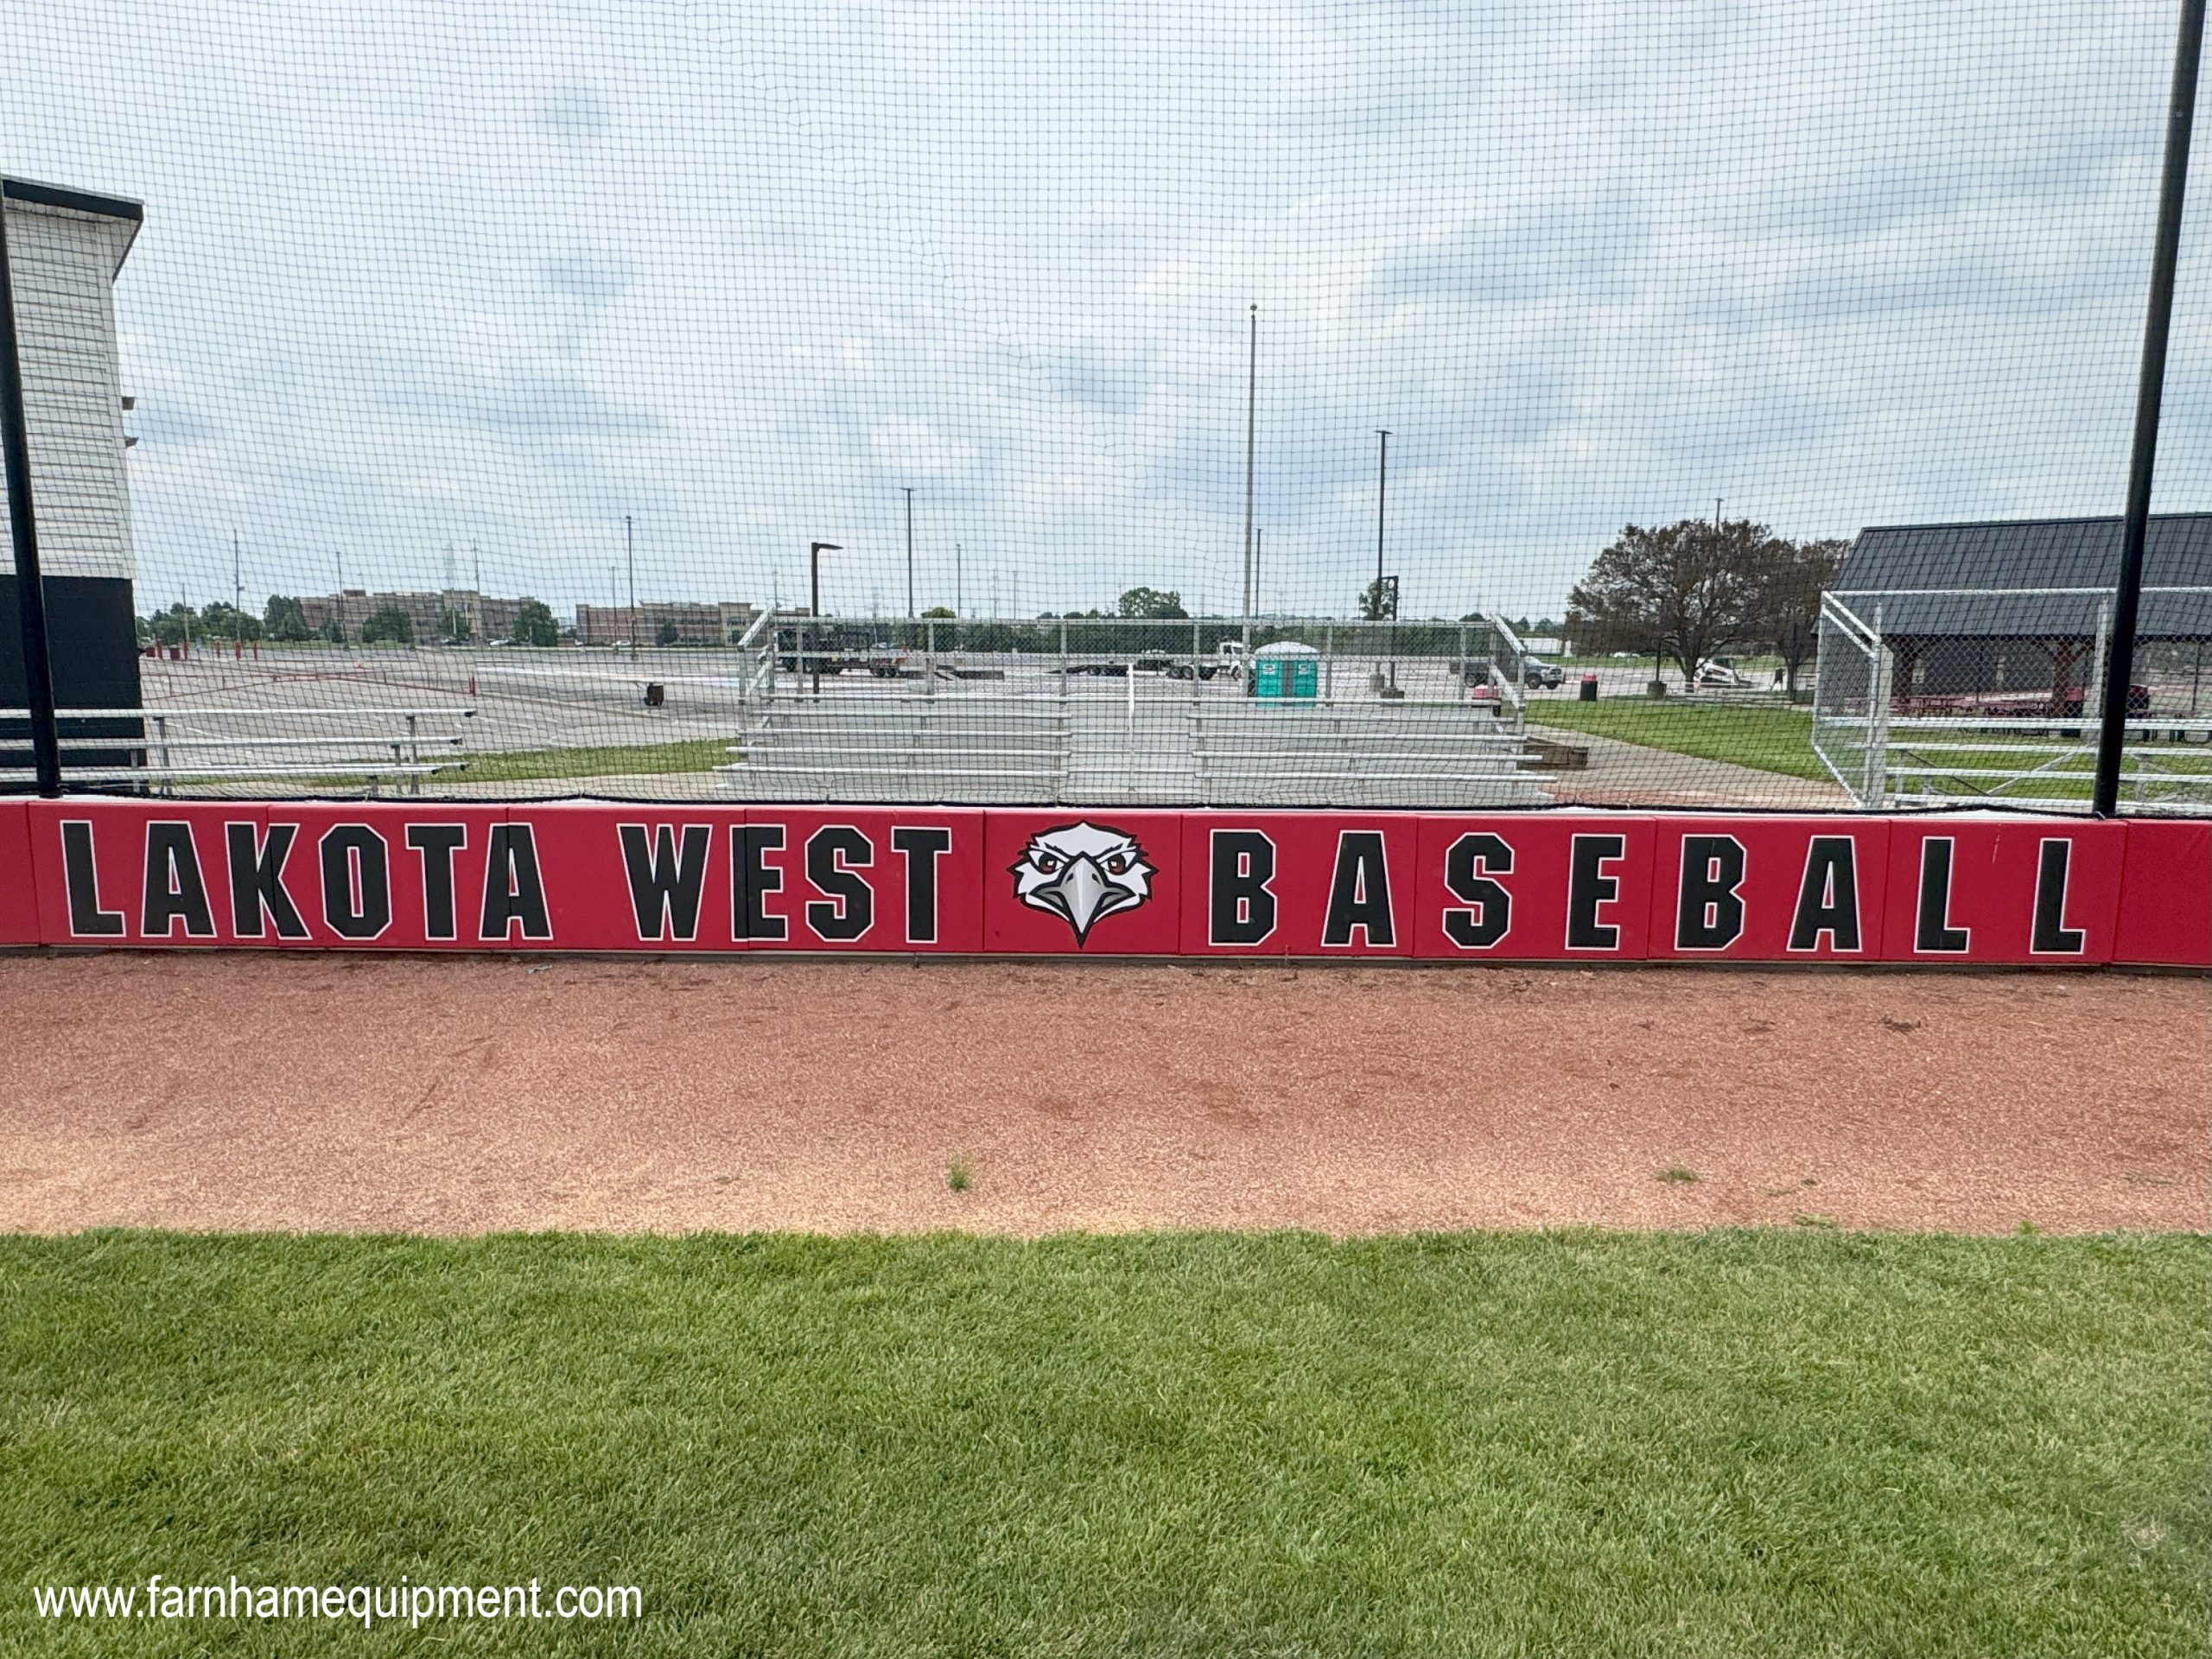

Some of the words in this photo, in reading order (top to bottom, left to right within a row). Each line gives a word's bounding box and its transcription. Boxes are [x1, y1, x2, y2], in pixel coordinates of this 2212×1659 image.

[59, 819, 554, 942] LAKOTA
[615, 823, 953, 944] WEST
[1207, 827, 2088, 957] BASEBALL
